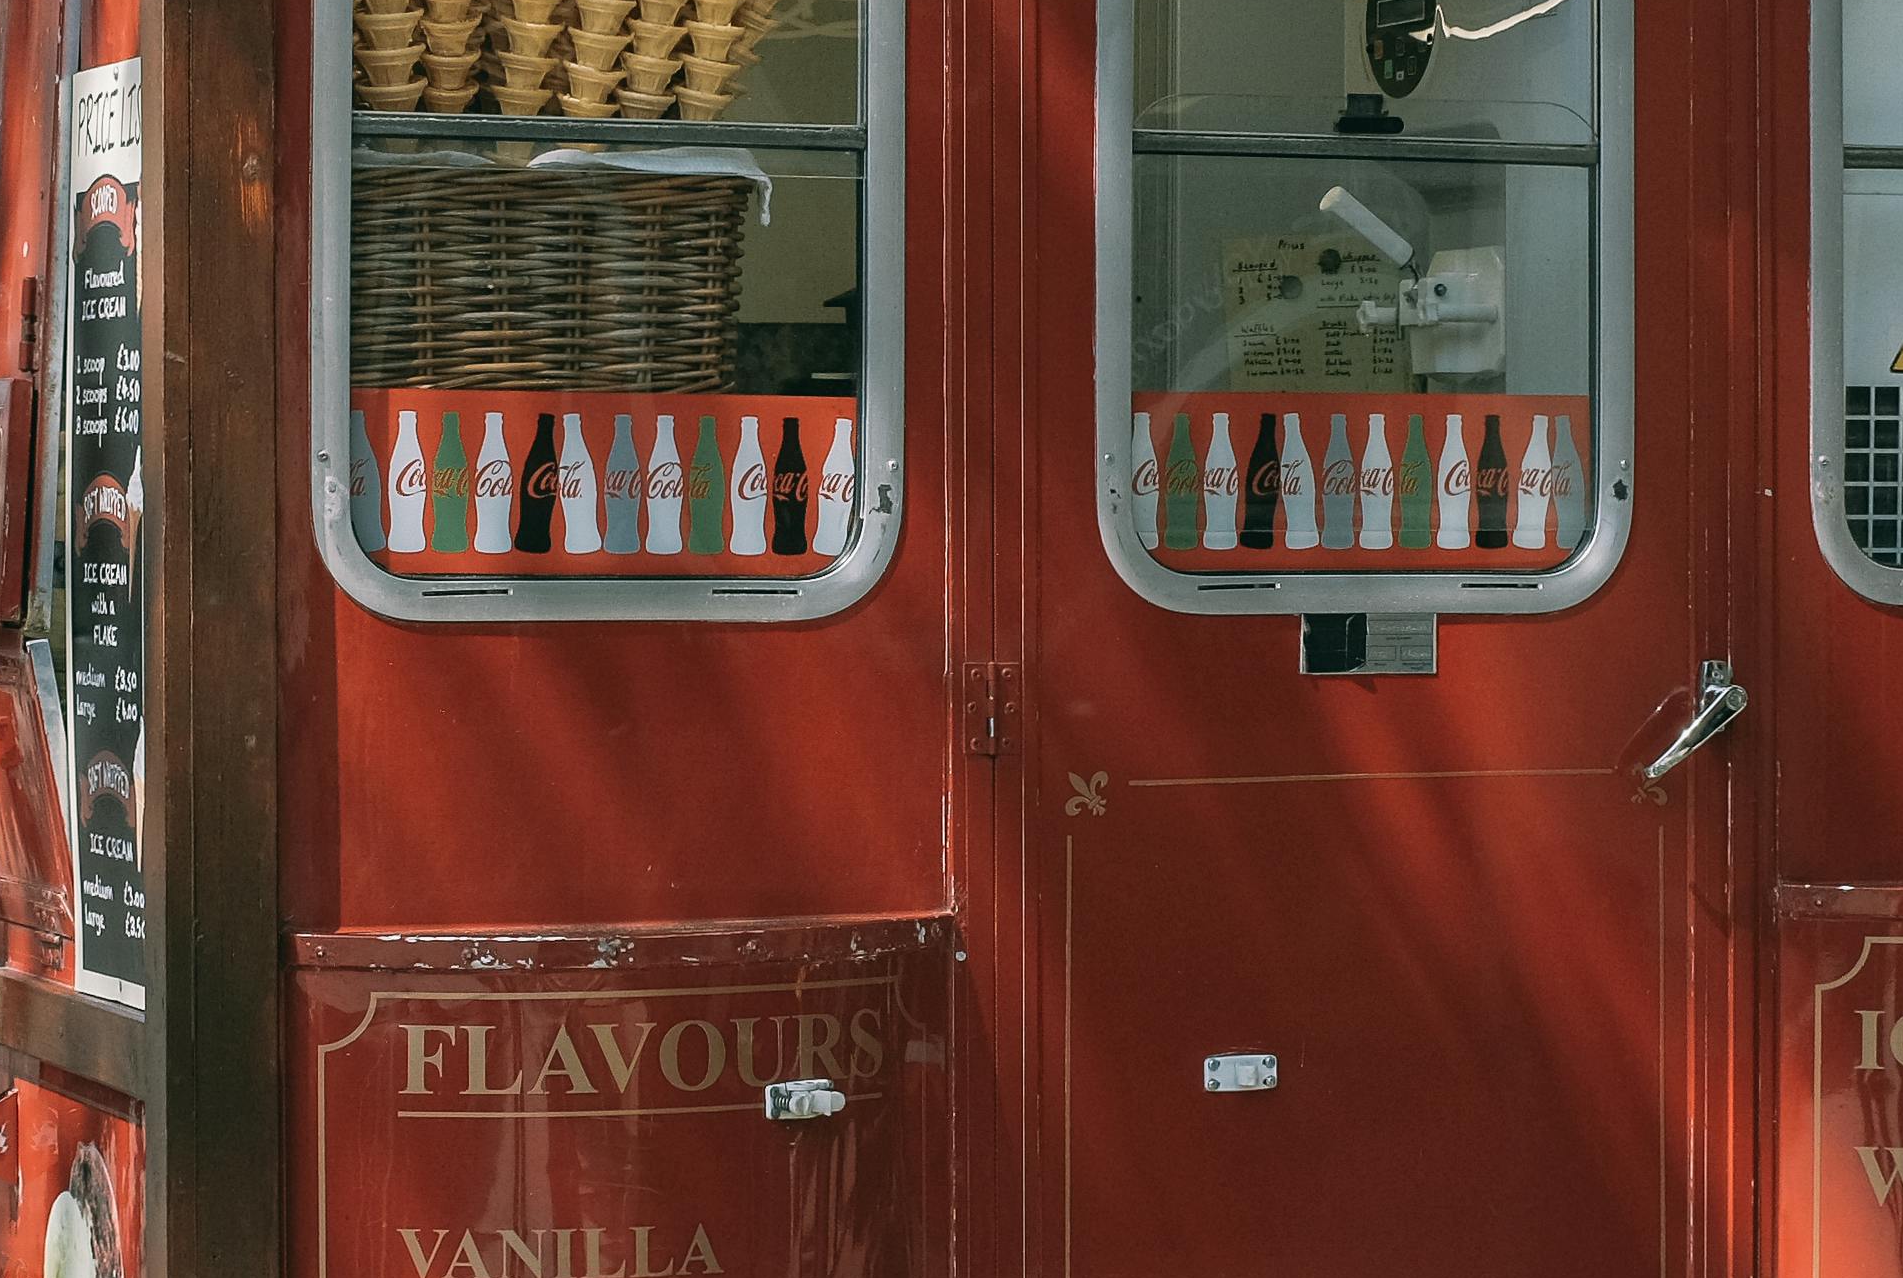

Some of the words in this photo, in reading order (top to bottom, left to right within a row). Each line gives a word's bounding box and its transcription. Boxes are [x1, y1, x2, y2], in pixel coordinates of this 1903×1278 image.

[77, 88, 118, 157] PRICE
[85, 260, 125, 289] Flavoured
[82, 299, 97, 321] ICE
[98, 296, 127, 320] CREAM
[76, 355, 81, 374] 1
[83, 357, 106, 386] scoop
[75, 385, 81, 405] 2
[82, 387, 108, 417] scoops
[82, 418, 108, 449] scoops
[83, 563, 98, 583] ICE
[99, 563, 128, 586] CREAM
[91, 592, 108, 615] with
[109, 600, 116, 616] a
[93, 625, 119, 647] FLAKE
[75, 663, 106, 688] medium
[114, 665, 138, 693] £3.50
[115, 697, 139, 723] £4.00
[89, 832, 104, 855] ICE
[105, 836, 134, 862] CREAM
[83, 874, 114, 901] medium
[398, 1007, 885, 1096] FLAVOURS
